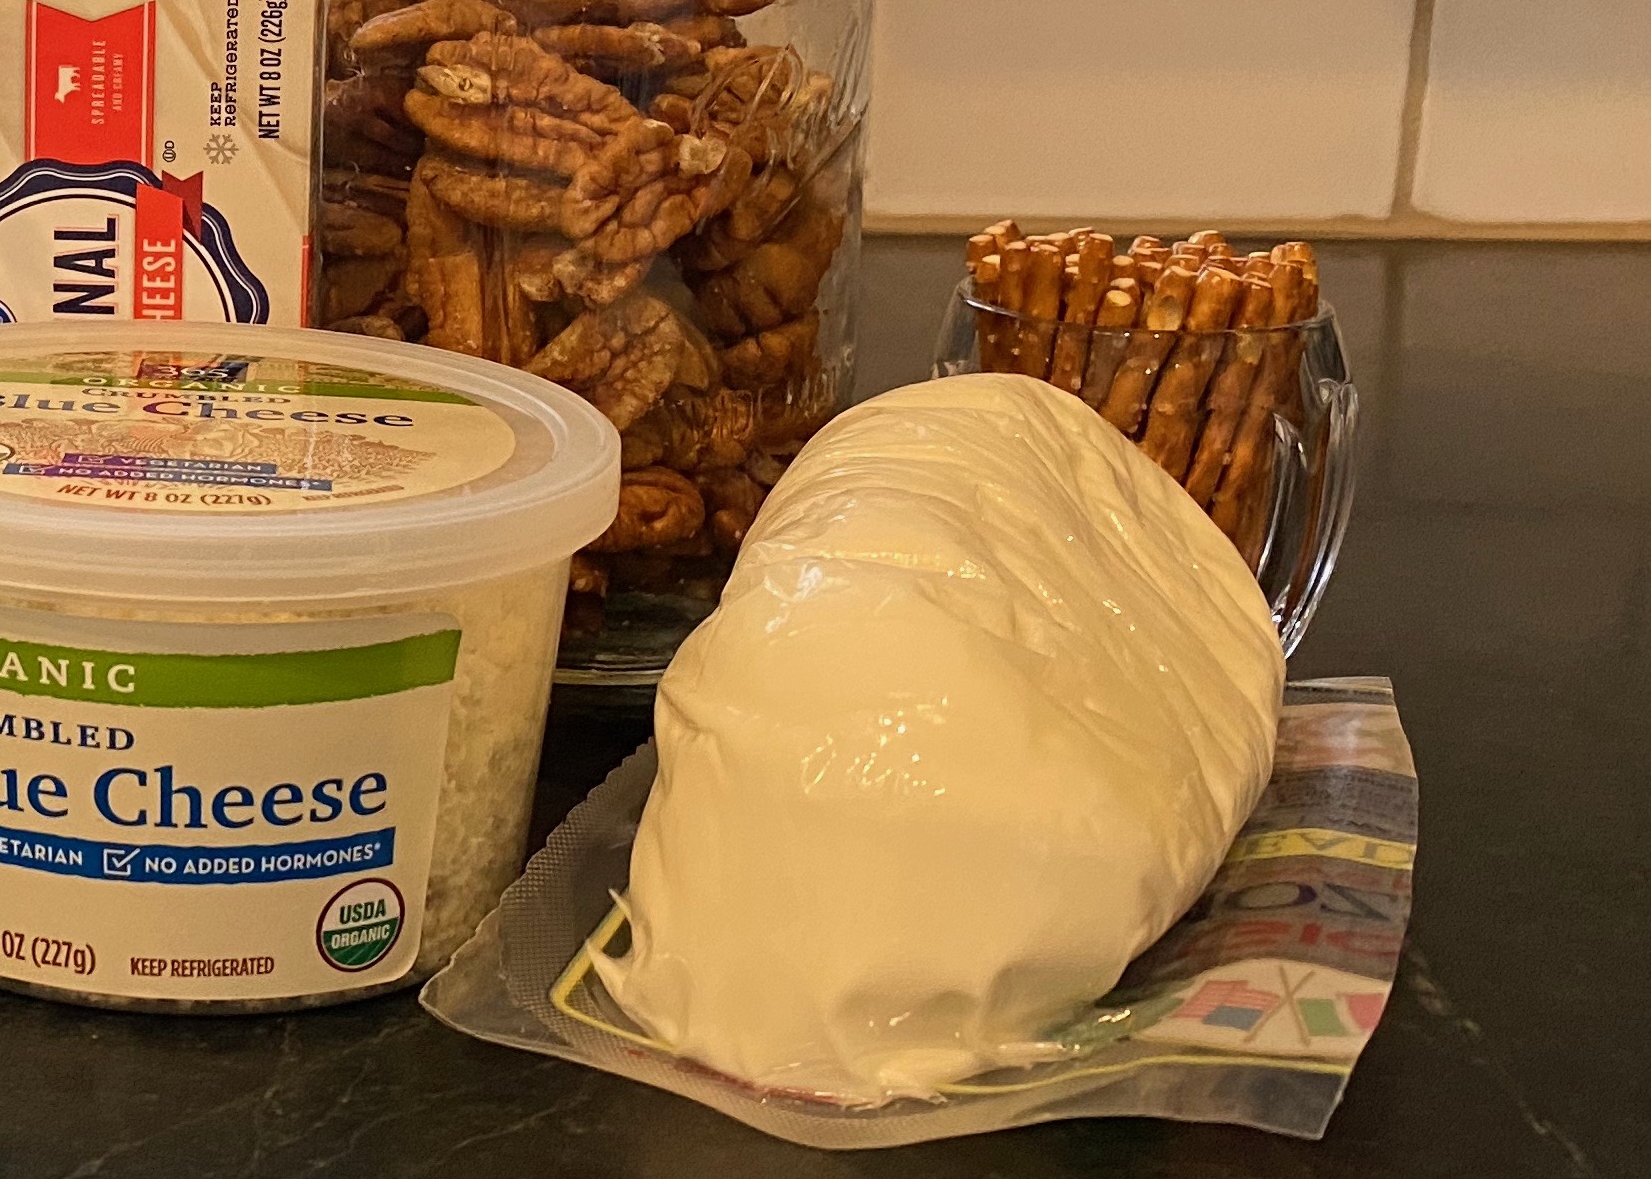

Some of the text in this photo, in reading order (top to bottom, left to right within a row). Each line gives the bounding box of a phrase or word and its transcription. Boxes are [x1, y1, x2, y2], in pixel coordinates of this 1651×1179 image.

[260, 47, 282, 66] OZ
[91, 38, 106, 125] SPREADABLE
[112, 52, 125, 112] AND CREAMY
[260, 70, 281, 79] 8
[209, 81, 222, 126] KEEP
[259, 83, 281, 106] WT
[258, 110, 280, 139] NET
[141, 238, 177, 320] HEESE
[81, 388, 291, 403] CRUMBLED
[82, 377, 301, 393] ORGANIC
[143, 401, 415, 427] Cheese
[59, 467, 91, 476] NO
[98, 469, 174, 480] ADDED
[121, 458, 261, 471] VEGETARIAN
[57, 484, 272, 506] NET WT 8 OZ (227g)
[93, 765, 388, 829] Cheese
[145, 857, 179, 874] NO
[184, 855, 255, 875] ADDED
[339, 899, 387, 924] USDA
[330, 923, 391, 948] ORGANIC
[1, 930, 26, 961] OZ
[32, 936, 97, 976] (227g)
[130, 957, 275, 978] KEEP REFRIGERATED
